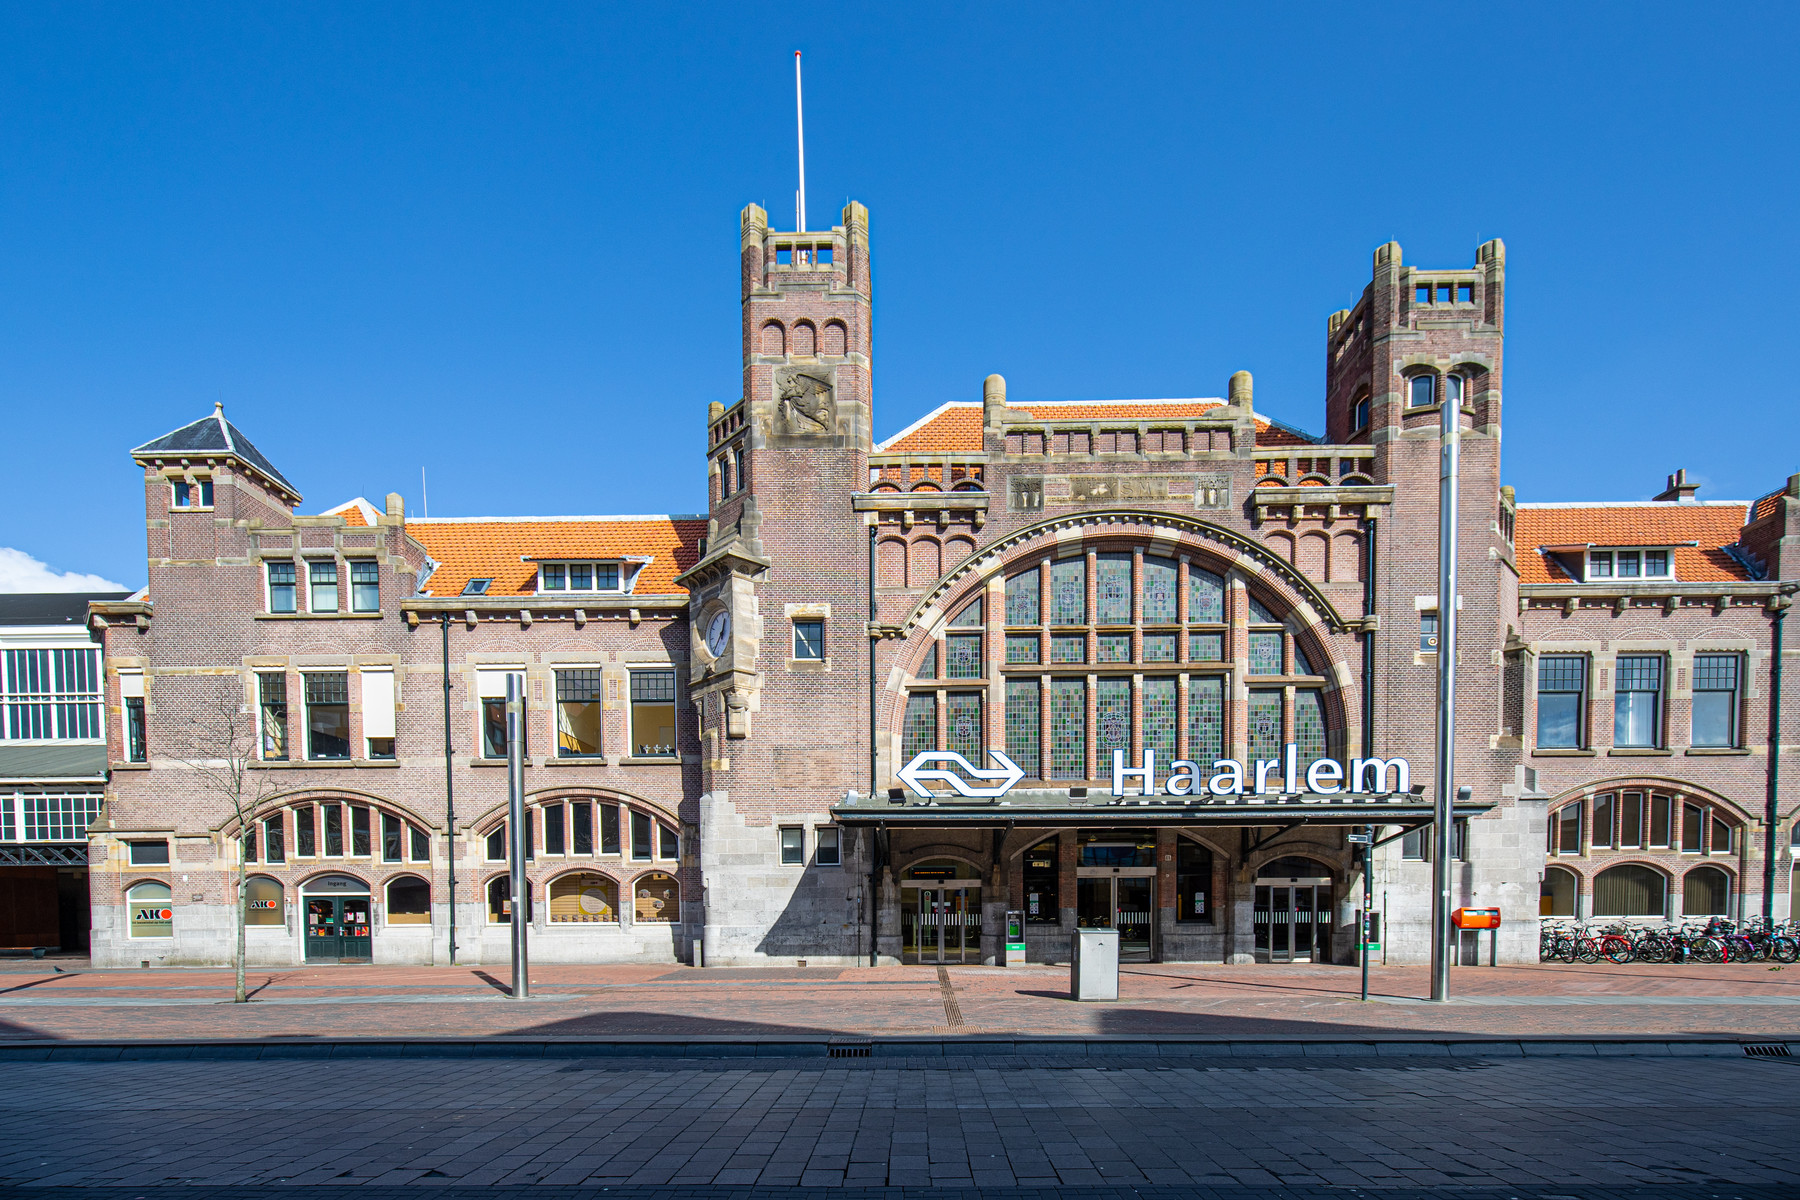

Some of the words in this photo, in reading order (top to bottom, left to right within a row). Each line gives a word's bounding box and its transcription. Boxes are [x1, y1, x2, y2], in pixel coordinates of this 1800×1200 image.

[1111, 743, 1410, 796] Haarlem
[251, 900, 276, 909] AKO
[136, 909, 173, 920] AKO
